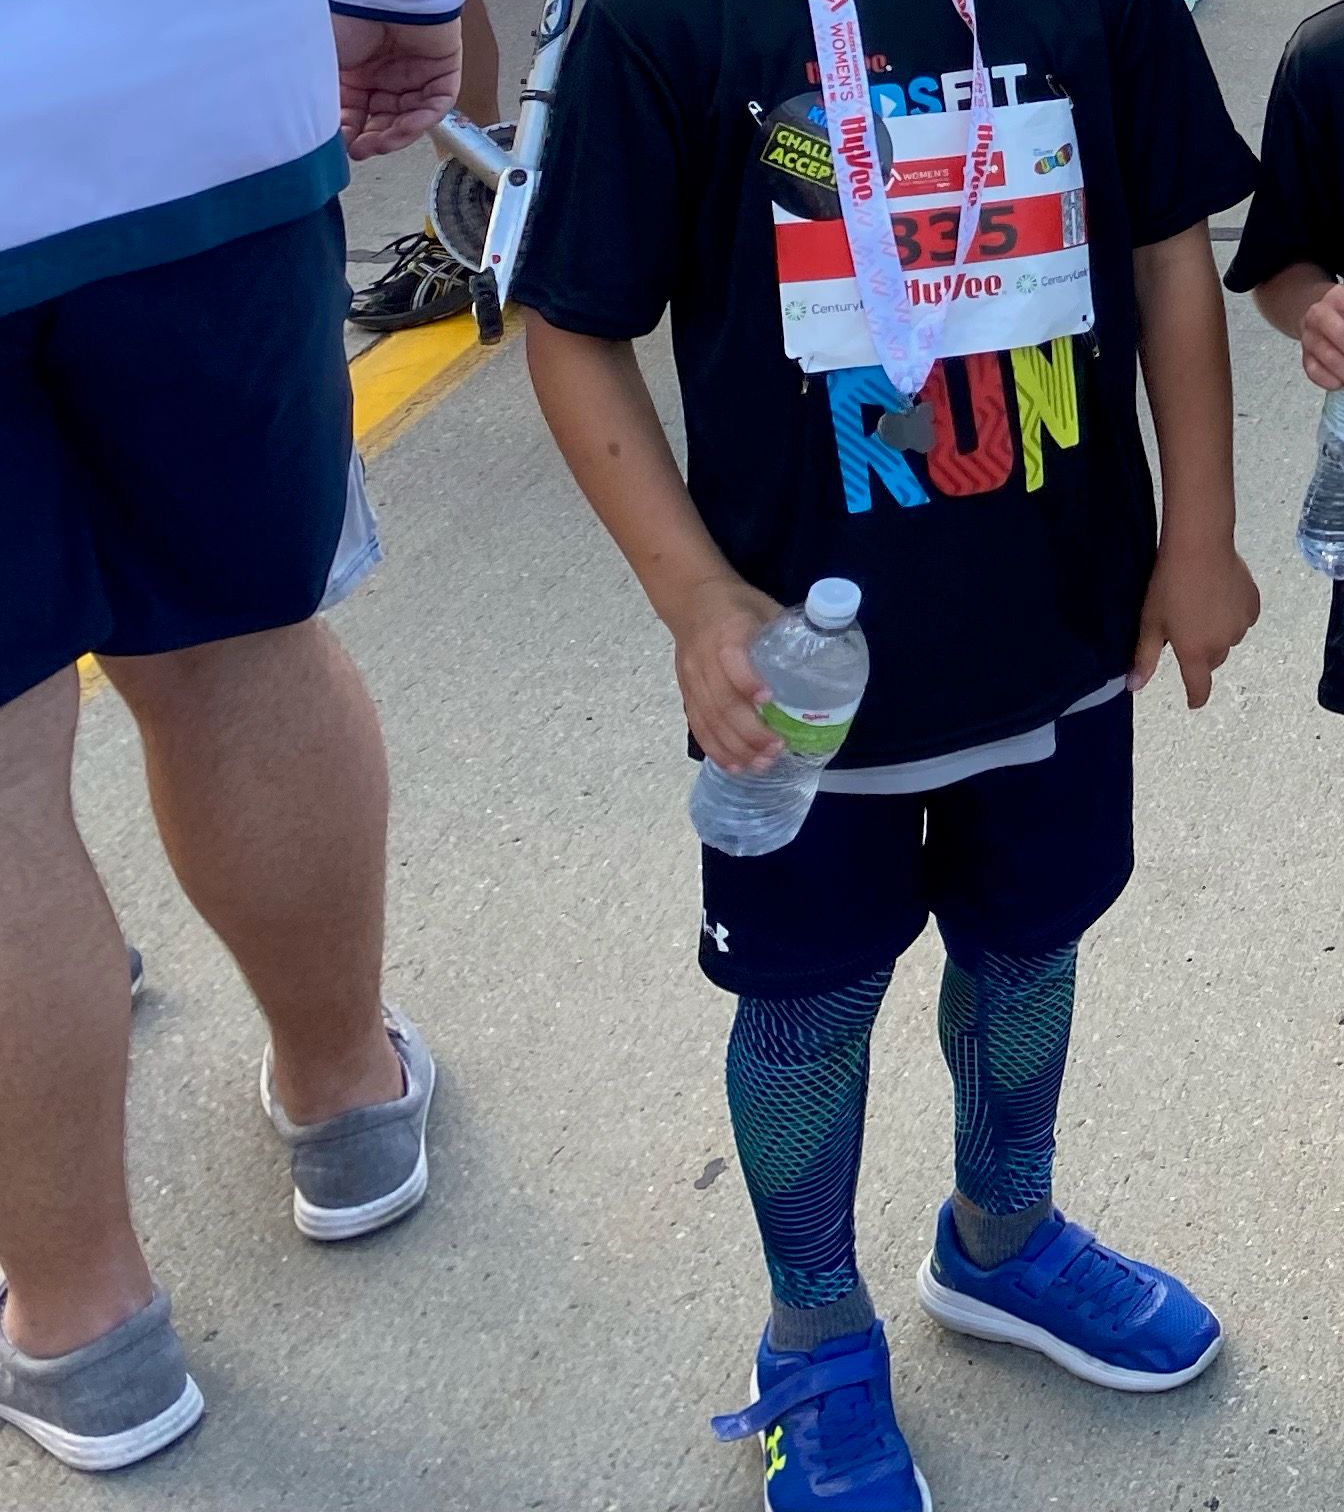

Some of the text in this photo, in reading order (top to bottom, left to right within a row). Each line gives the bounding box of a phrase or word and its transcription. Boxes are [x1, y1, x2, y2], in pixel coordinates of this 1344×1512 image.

[830, 23, 854, 101] WOMEN'S
[768, 147, 836, 184] ACCEP
[777, 130, 832, 163] CHALL
[838, 115, 873, 201] HyVee
[891, 206, 1018, 265] 835
[827, 336, 1079, 514] RUN
